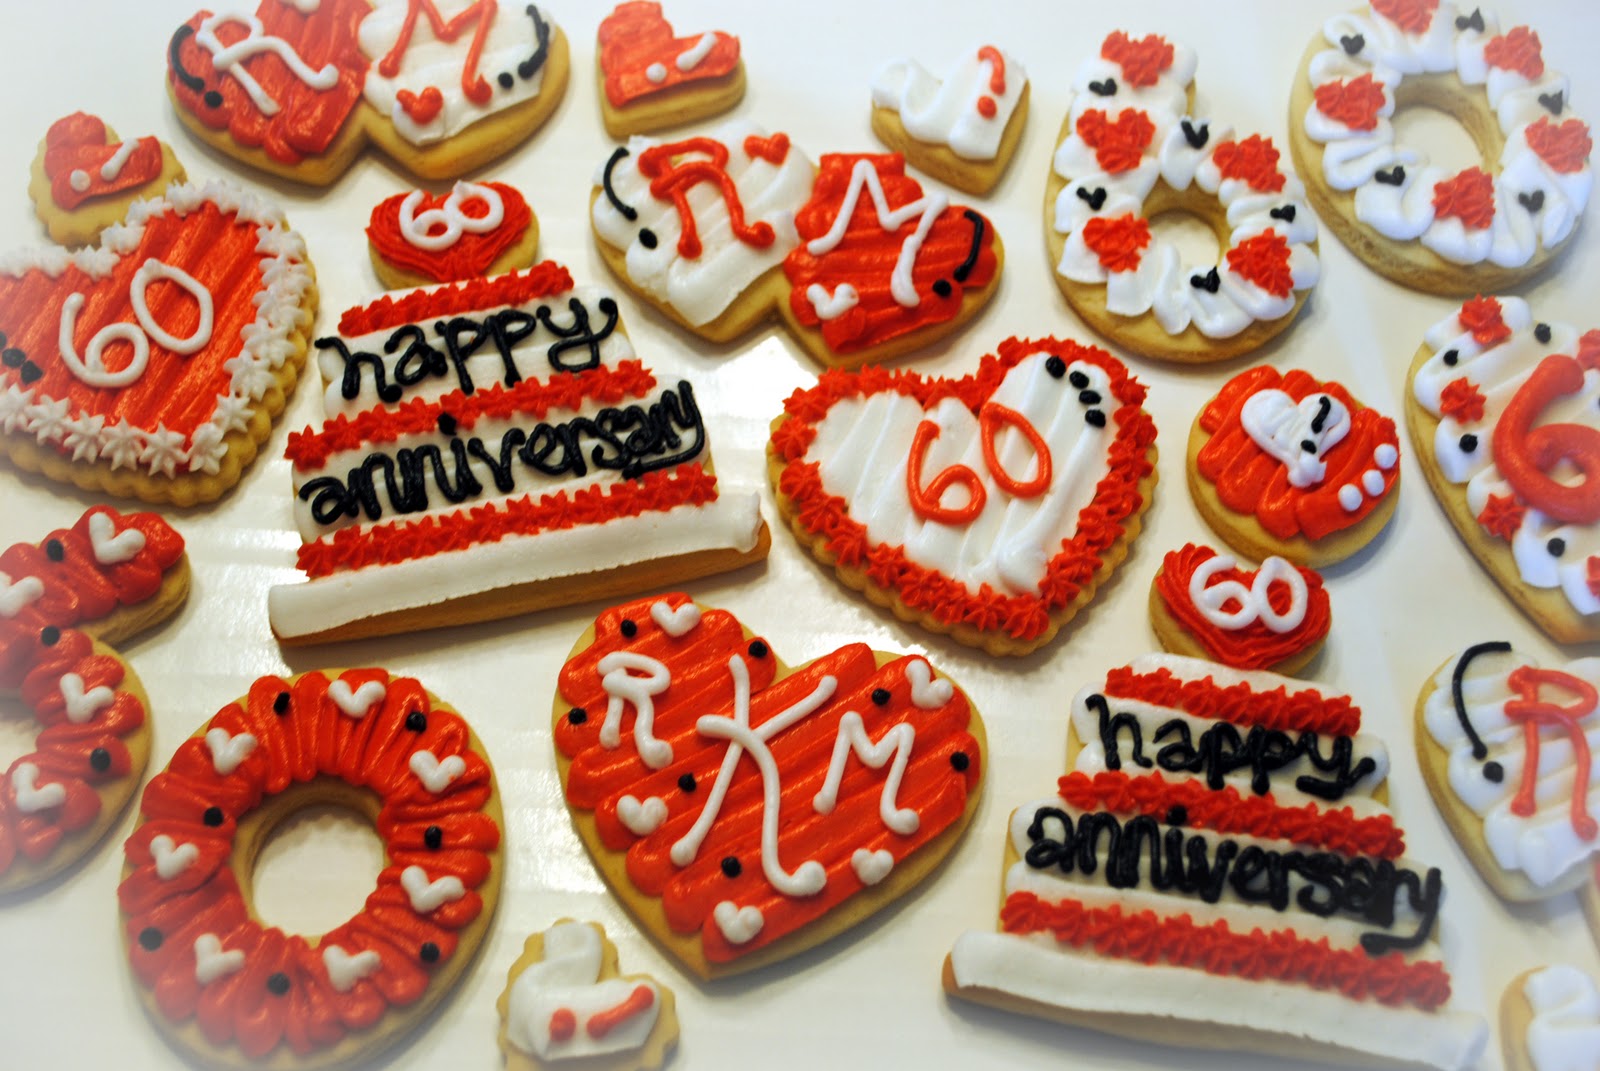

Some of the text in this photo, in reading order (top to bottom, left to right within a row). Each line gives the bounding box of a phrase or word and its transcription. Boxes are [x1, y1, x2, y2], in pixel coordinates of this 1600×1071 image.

[400, 181, 504, 250] 60
[59, 259, 214, 387] 60
[314, 297, 618, 402] happy
[299, 379, 706, 524] anniversary
[908, 402, 1052, 524] 60
[1189, 555, 1307, 633] 60
[1085, 693, 1376, 800] happy
[1025, 805, 1442, 955] anniversary
